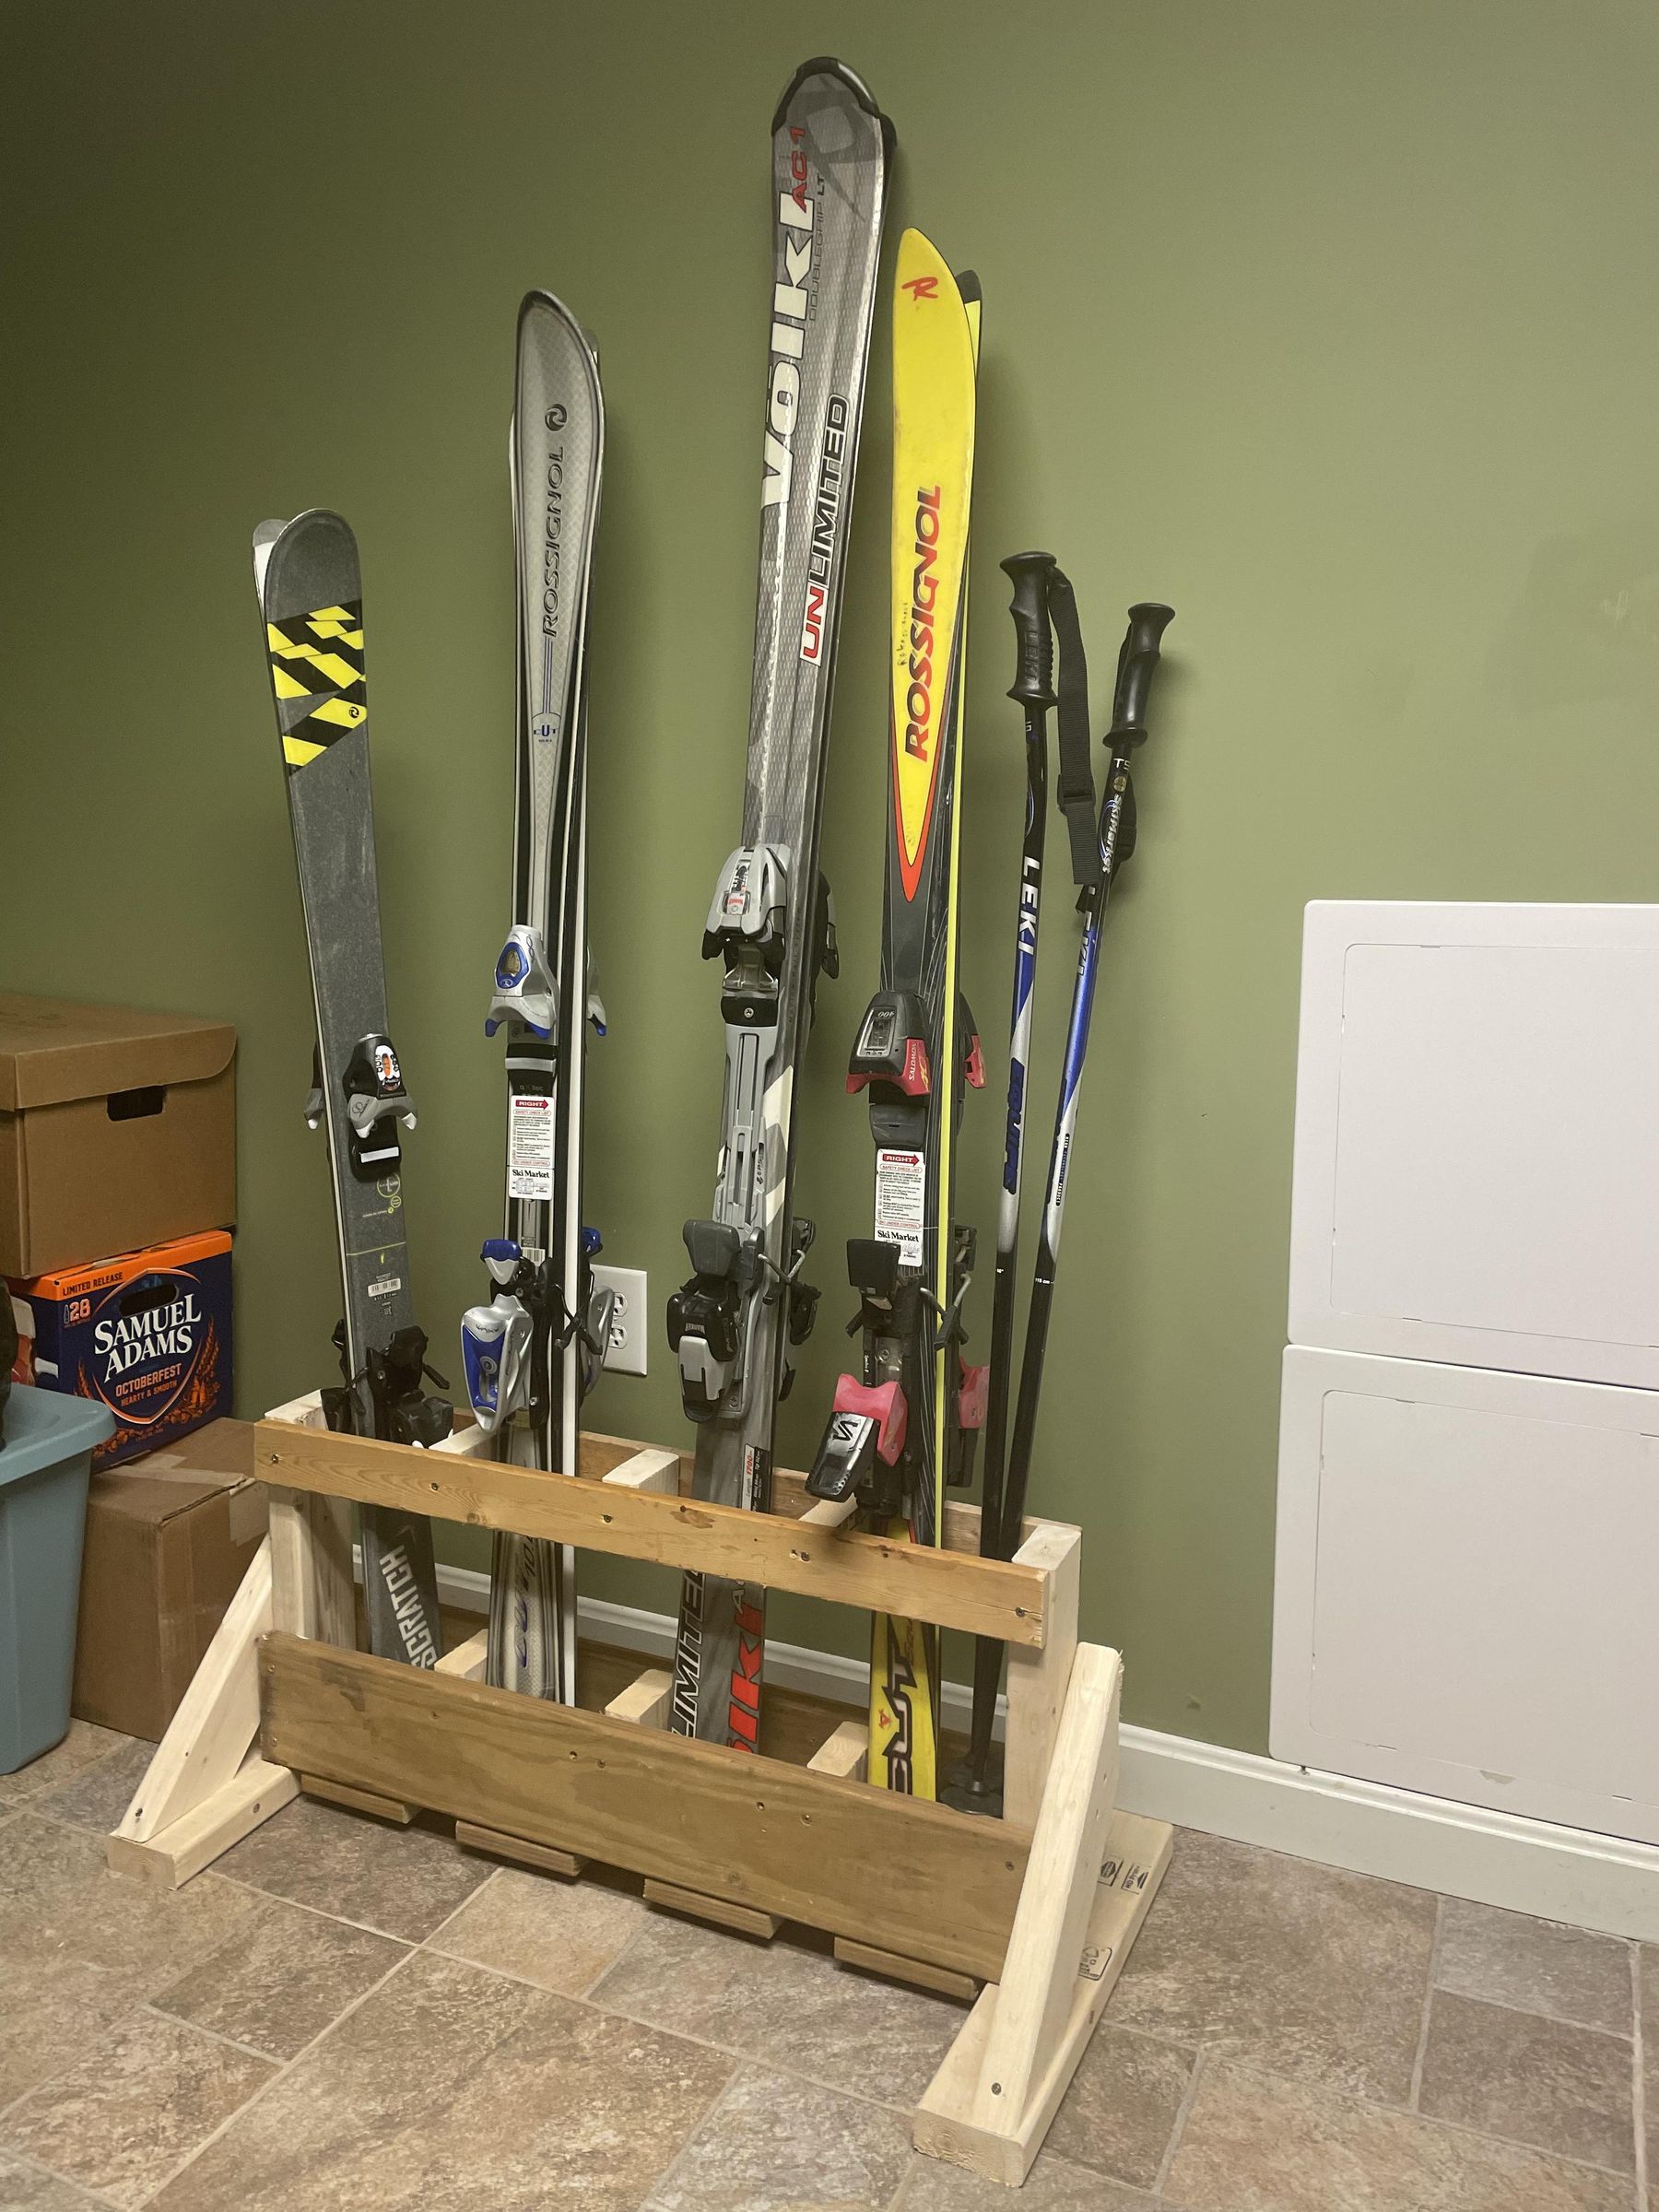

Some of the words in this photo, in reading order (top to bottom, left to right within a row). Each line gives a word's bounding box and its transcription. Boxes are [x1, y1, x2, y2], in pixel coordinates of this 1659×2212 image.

[809, 203, 824, 322] DOUBLEGRIP
[542, 446, 563, 639] ROSSIGNOL
[800, 394, 850, 666] UNLIMITED
[905, 485, 940, 762] ROSSIGNOL
[1018, 855, 1040, 955] LEKI
[909, 1043, 917, 1081] SALOMON
[512, 1169, 524, 1177] Ski
[524, 1170, 550, 1179] Market
[877, 1230, 890, 1239] Ski
[891, 1231, 920, 1242] Market
[63, 1281, 91, 1296] LIMITED
[92, 1272, 124, 1288] RELEASE
[69, 1298, 91, 1322] 28
[94, 1293, 202, 1355] SAMUEL
[103, 1325, 193, 1383] ADAMS
[115, 1362, 182, 1397] OCTOBERFEST
[121, 1393, 147, 1407] HEARTY
[153, 1380, 178, 1395] SMOOTH
[380, 1545, 438, 1669] SCRATCH
